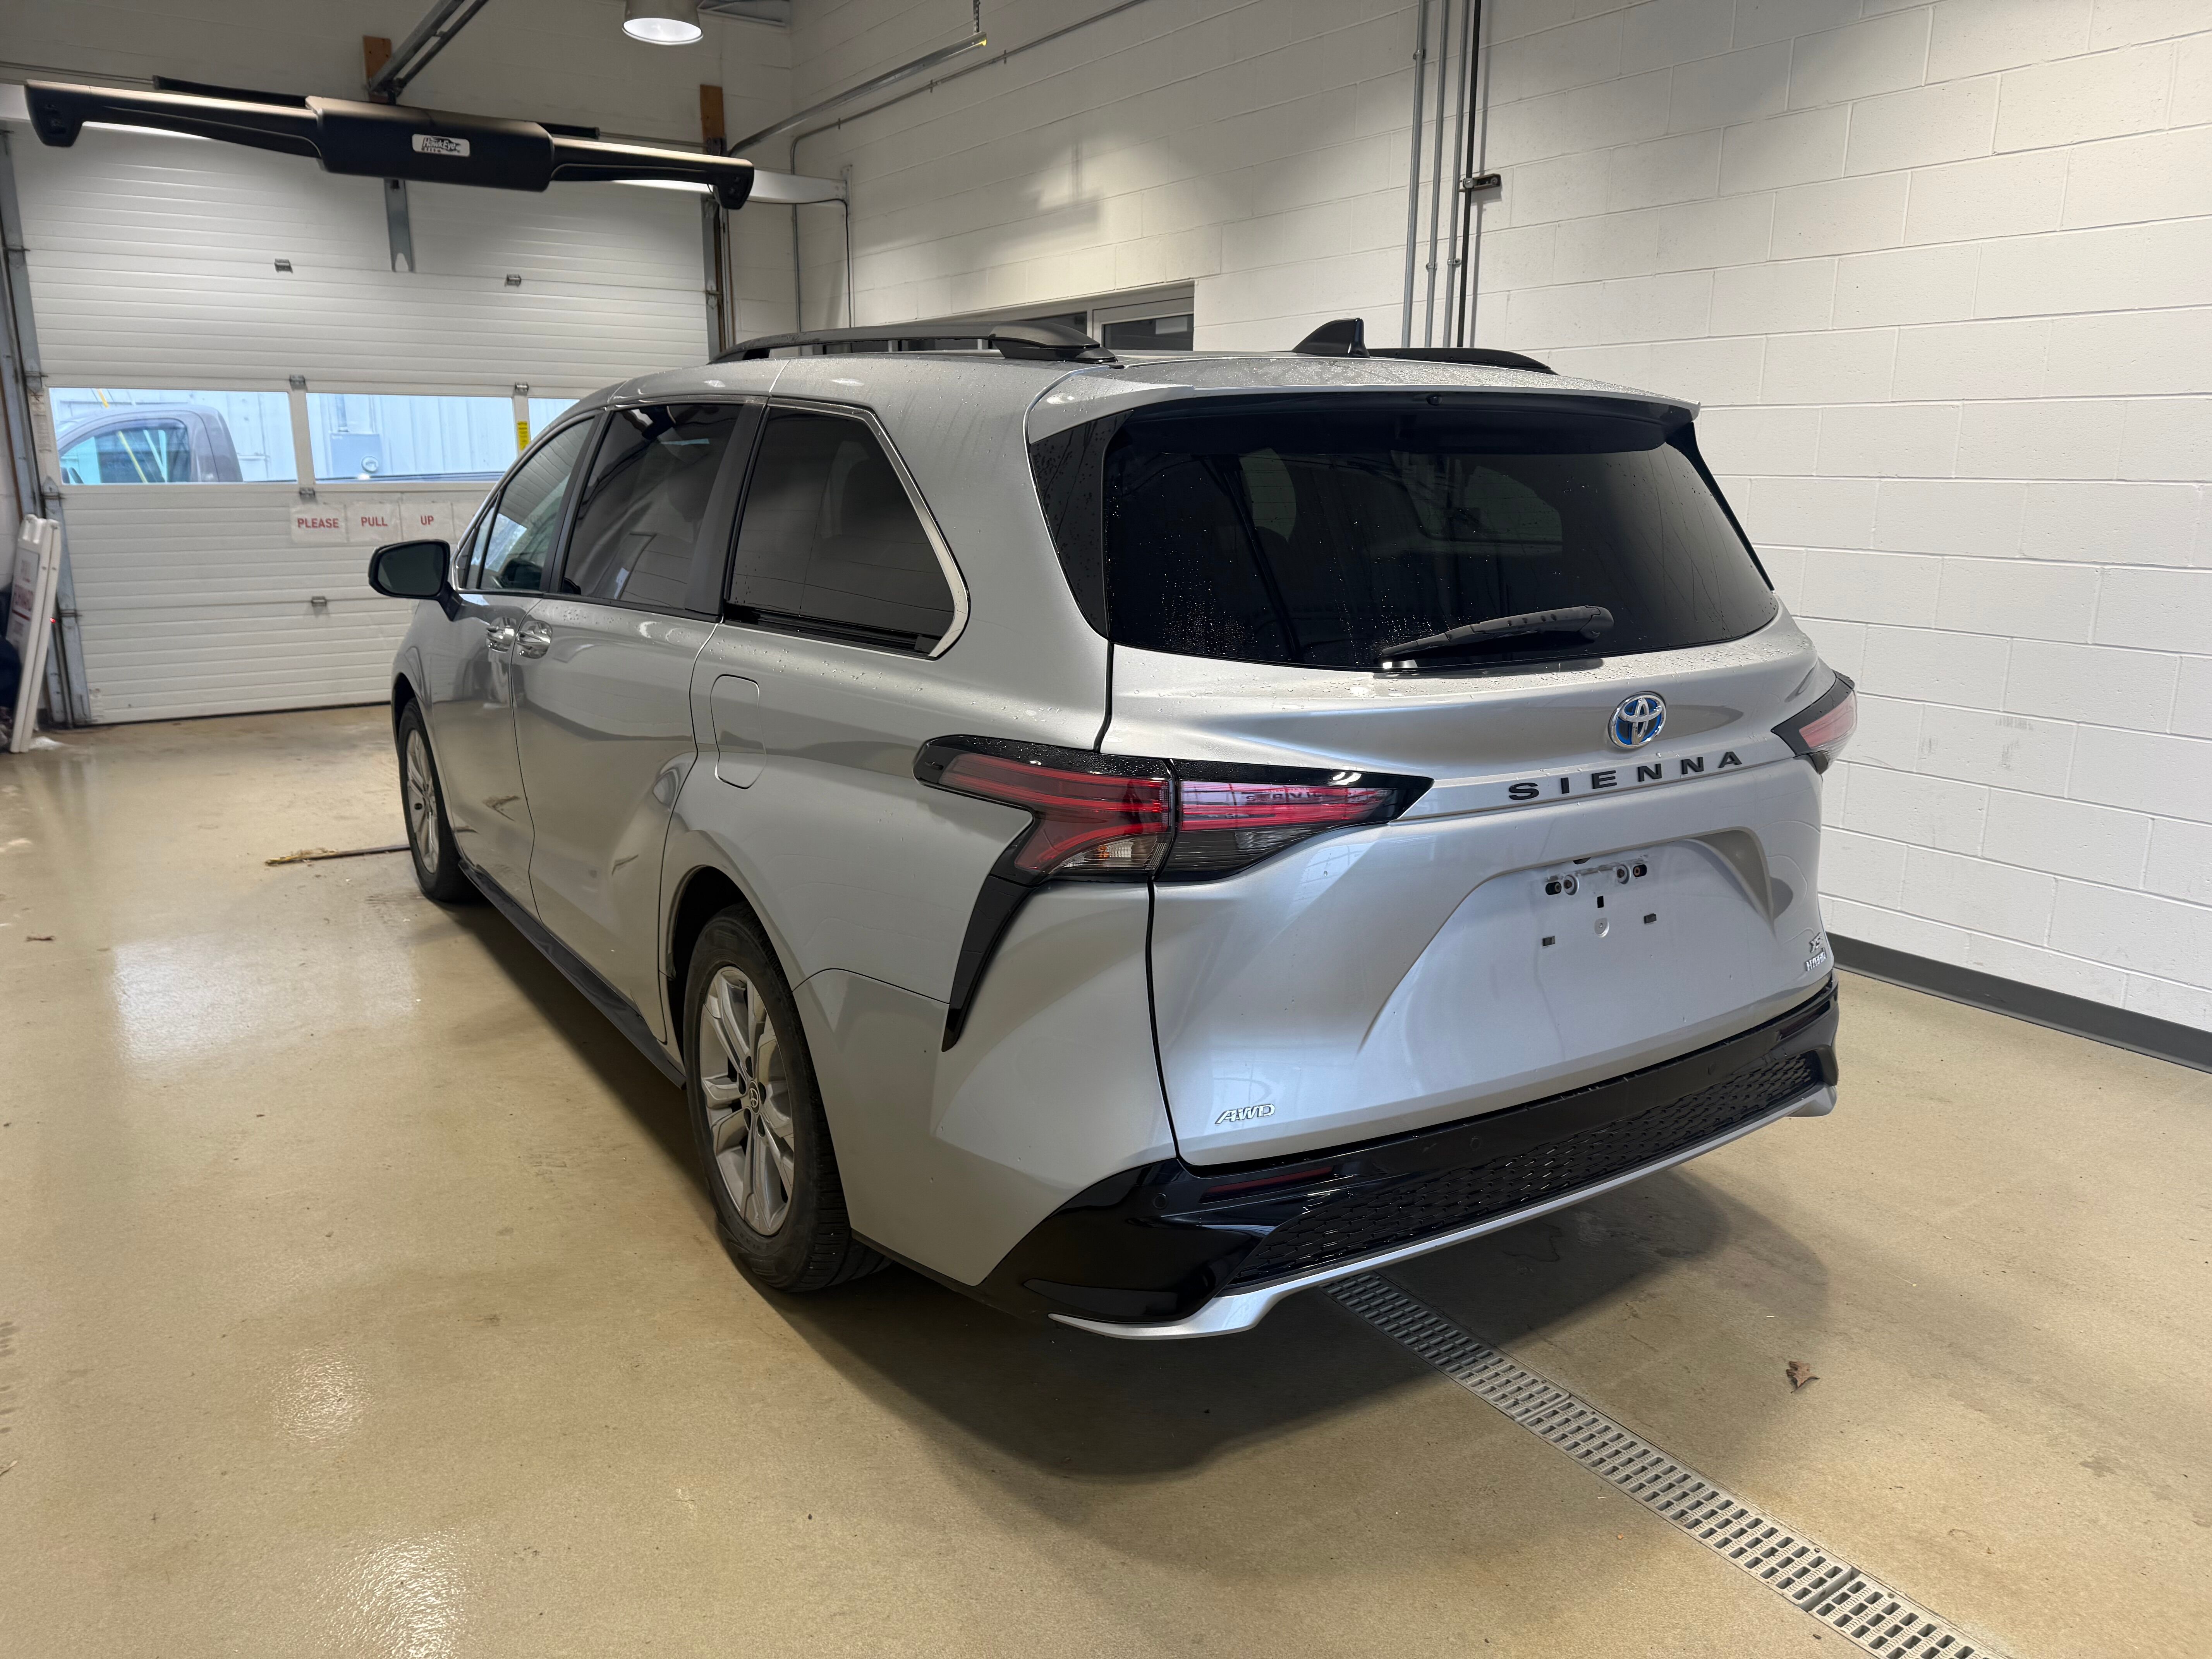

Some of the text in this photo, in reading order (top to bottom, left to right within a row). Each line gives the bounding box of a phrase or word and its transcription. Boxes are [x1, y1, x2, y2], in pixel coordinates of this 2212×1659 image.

[422, 137, 456, 150] HawkEye
[297, 515, 434, 528] PLEASE PULL UP
[1508, 751, 1743, 800] SIENNA
[1214, 1104, 1276, 1125] AWD
